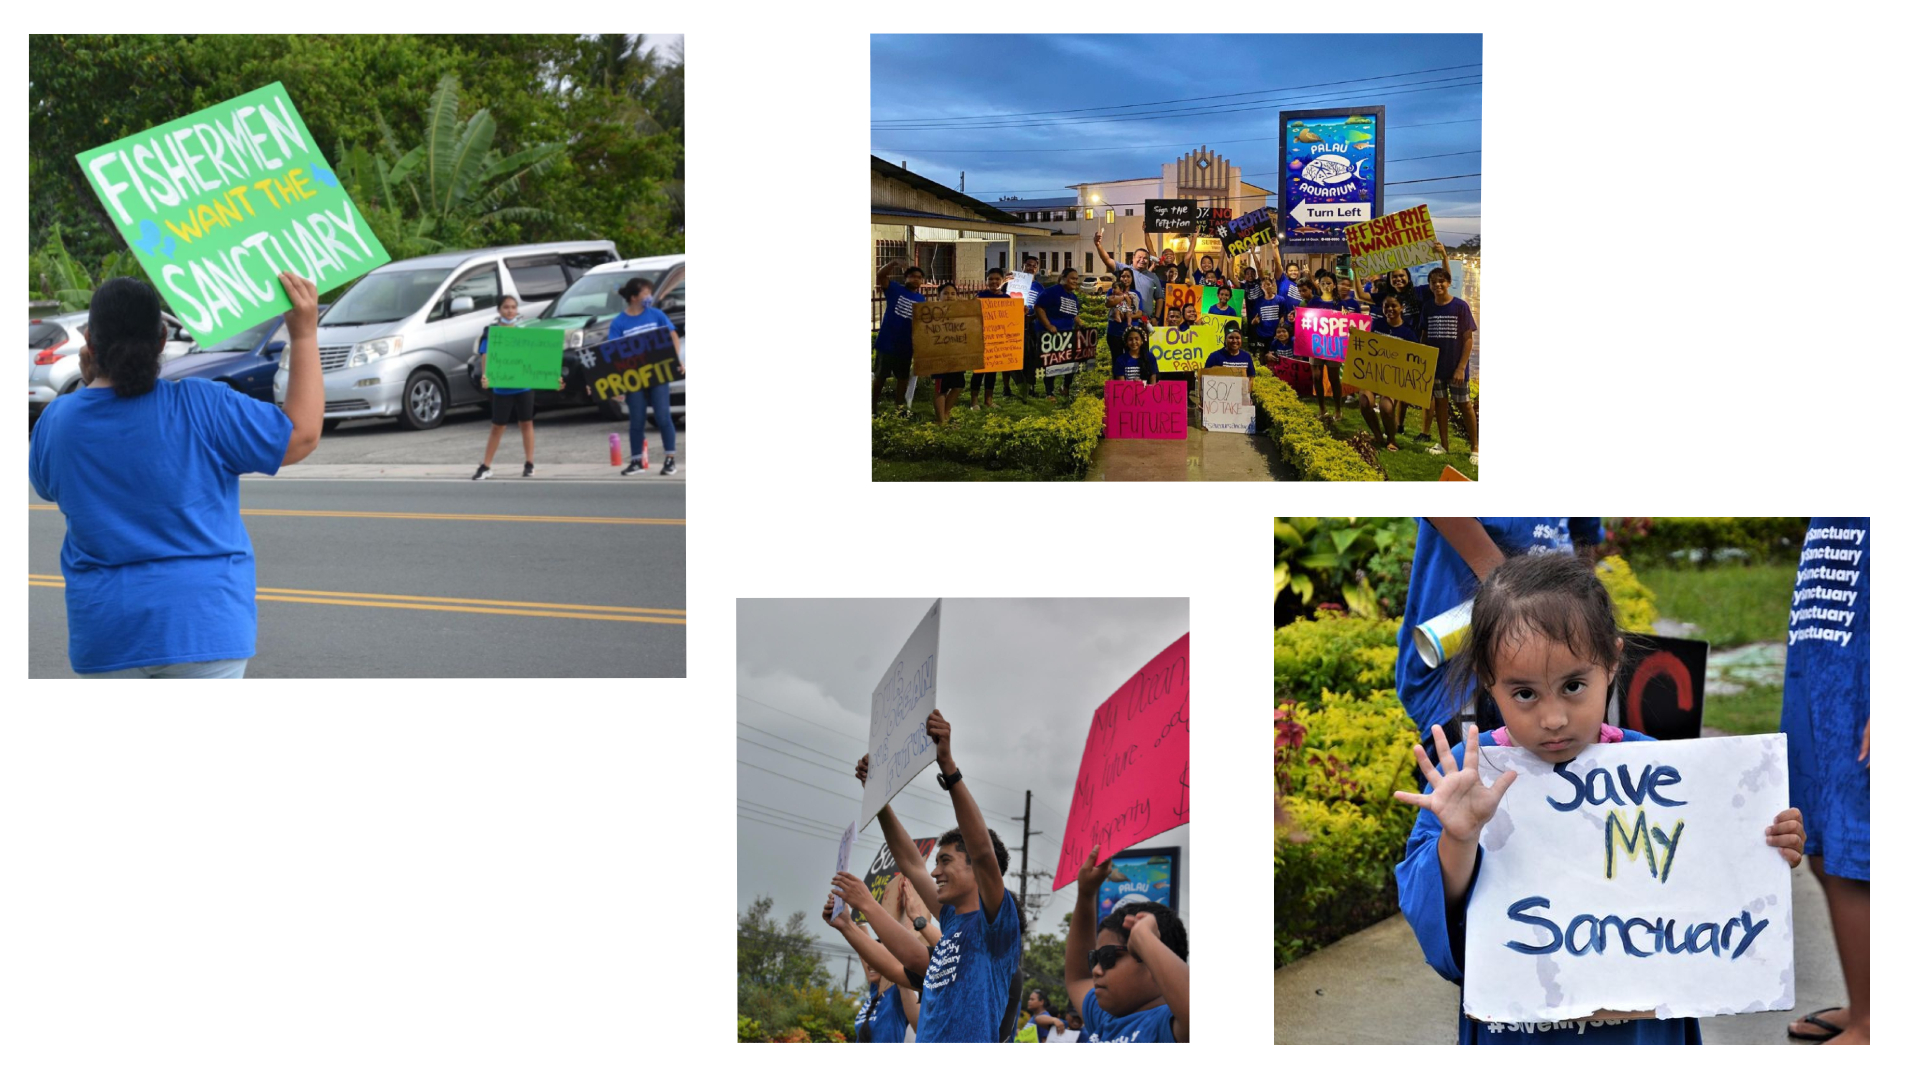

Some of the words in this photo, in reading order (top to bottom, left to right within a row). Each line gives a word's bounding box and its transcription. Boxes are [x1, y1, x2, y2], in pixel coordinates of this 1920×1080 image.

[89, 95, 309, 226] FISHERMEN
[1310, 143, 1348, 155] PALAU
[1299, 182, 1357, 197] AQUARIUM
[165, 185, 256, 243] WANT
[254, 168, 317, 209] THE
[1213, 208, 1232, 219] NO
[1307, 208, 1334, 217] Turn
[1337, 207, 1362, 217] Left
[1228, 227, 1271, 256] PROFIT
[162, 199, 373, 335] SANCTUARY
[920, 304, 952, 324] 80%
[925, 324, 941, 335] NO
[1041, 331, 1073, 353] 80%
[1076, 328, 1098, 352] NO
[1166, 327, 1199, 345] Our
[1040, 349, 1073, 366] TAKE
[1149, 345, 1203, 360] Ocean
[1406, 352, 1427, 375] my
[595, 357, 675, 400] PROFIT
[1353, 357, 1433, 394] SANCTUARY
[1113, 383, 1149, 407] FOR
[1152, 383, 1183, 405] OUR
[1203, 401, 1219, 415] NO
[1221, 402, 1243, 415] TAKE
[1119, 411, 1183, 439] FUTURE
[1546, 756, 1689, 812] Save
[1118, 882, 1150, 895] PALAU
[1502, 895, 1770, 962] Sanctuary
